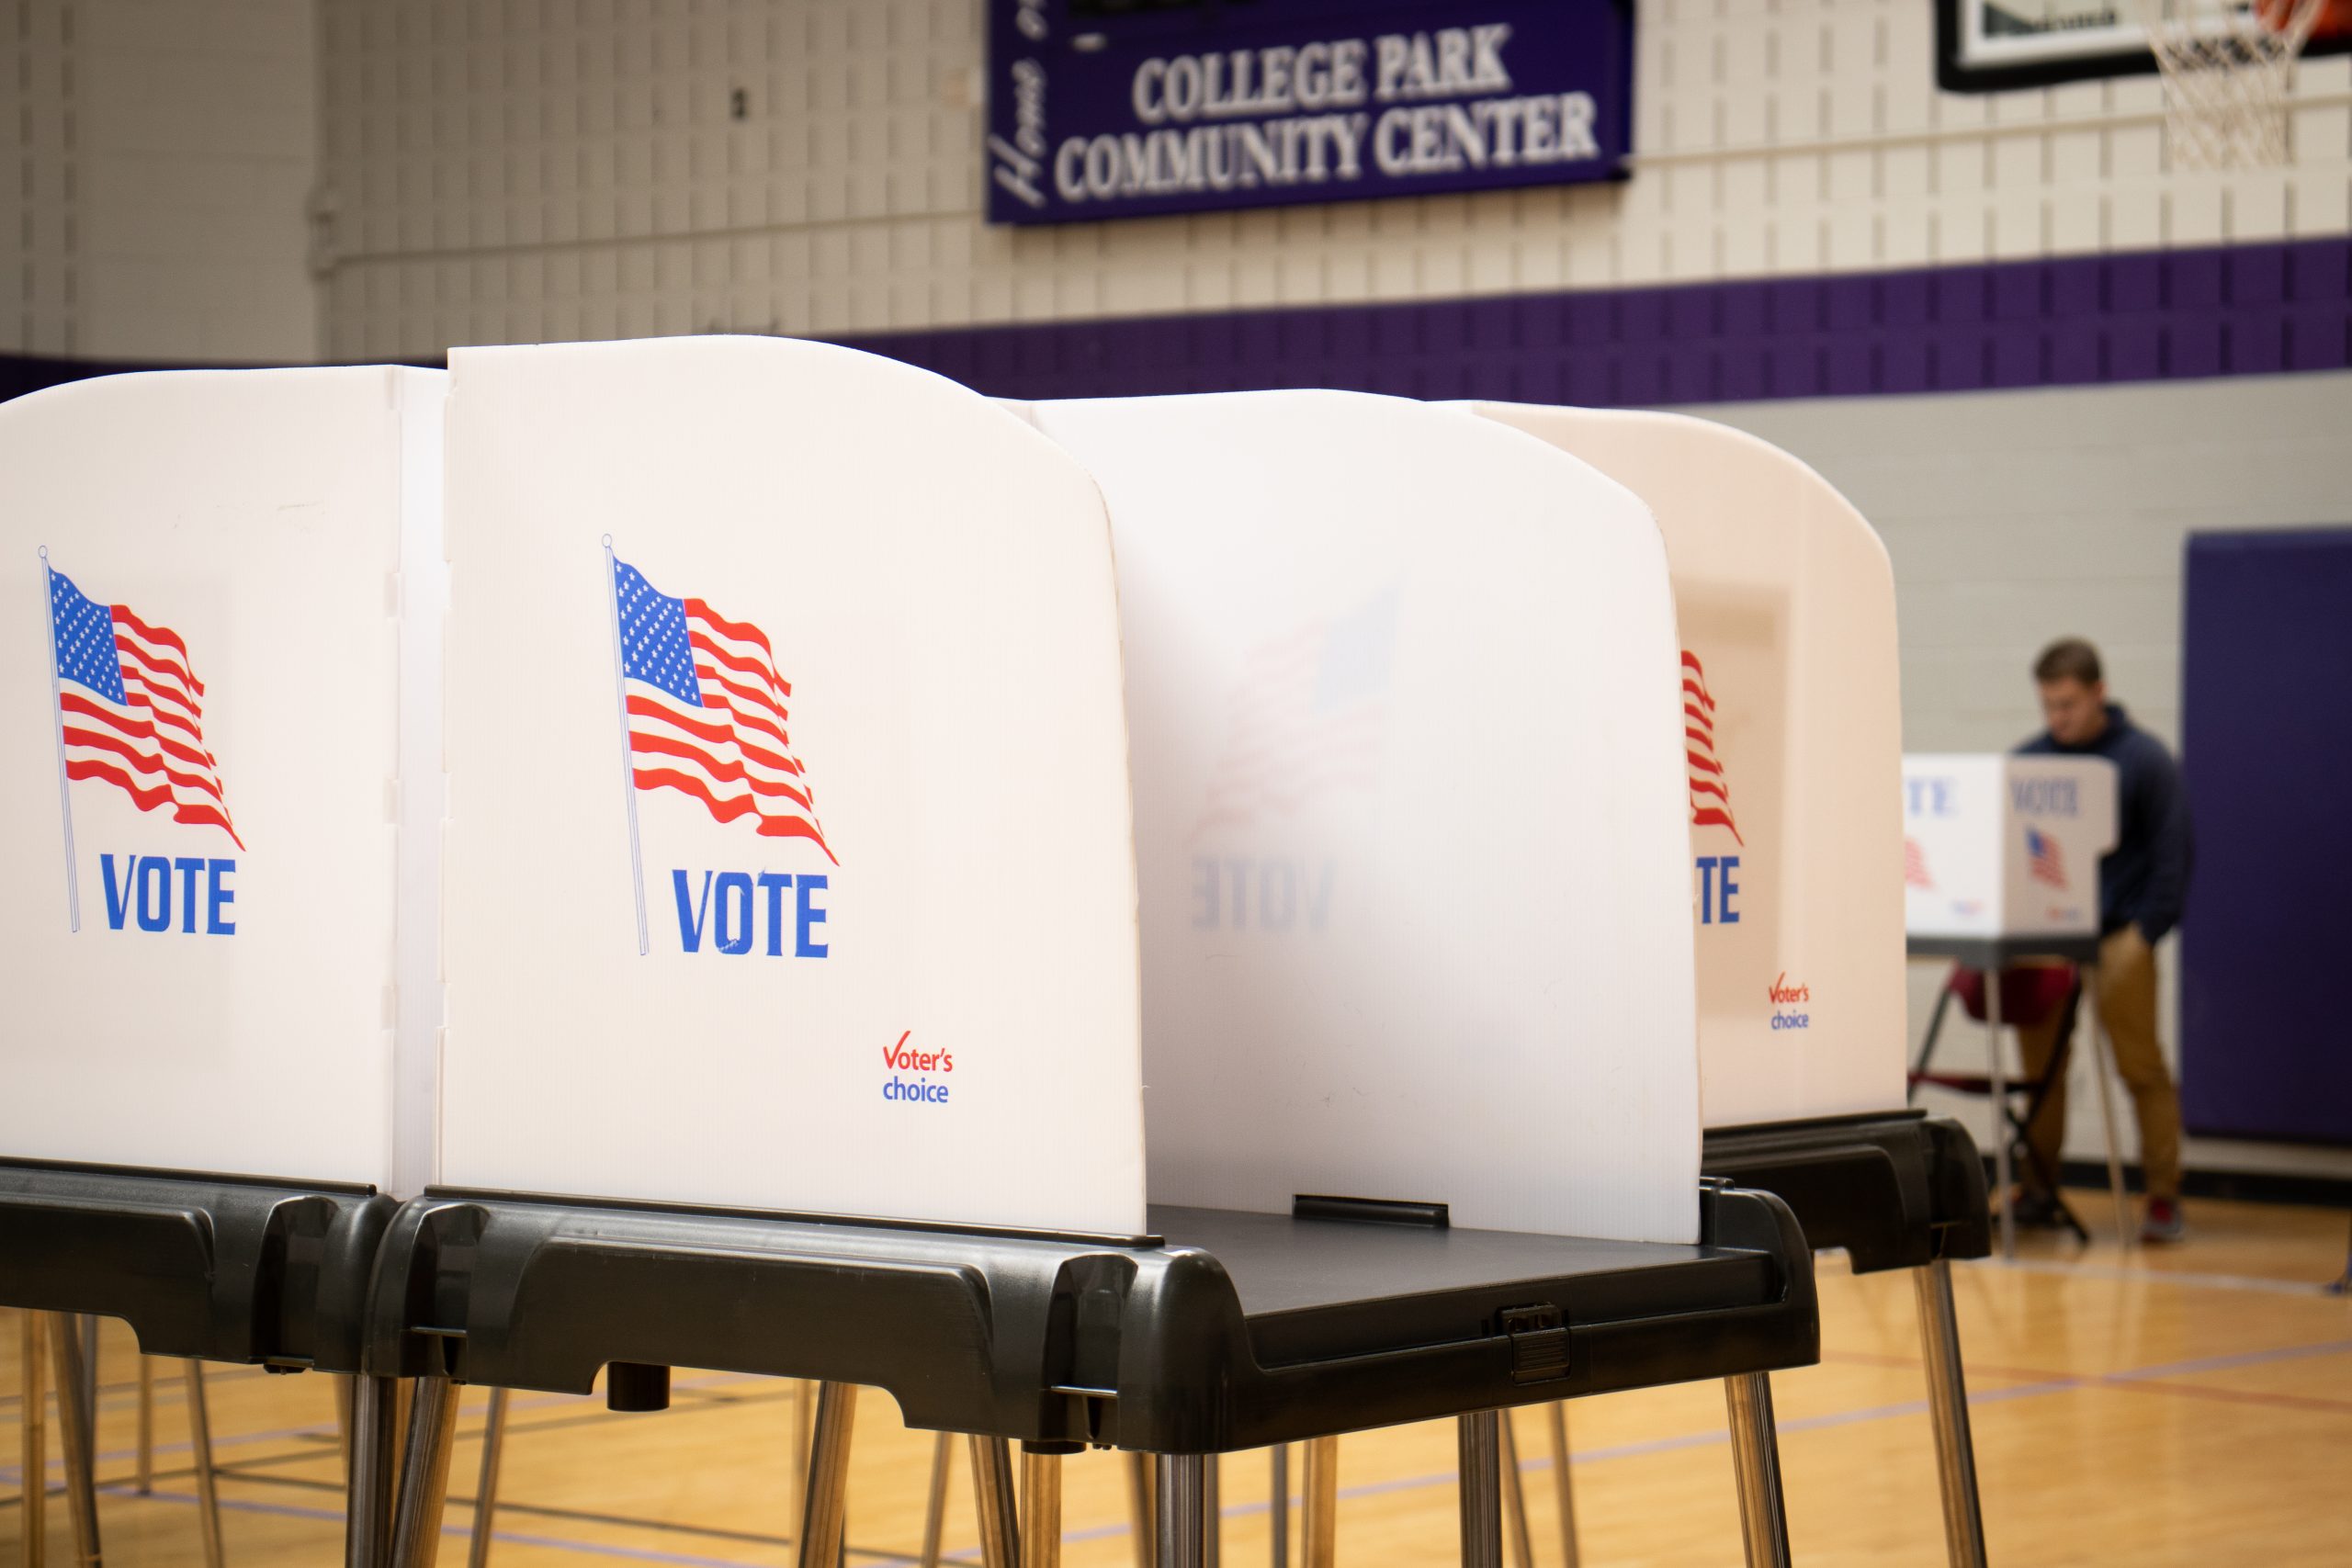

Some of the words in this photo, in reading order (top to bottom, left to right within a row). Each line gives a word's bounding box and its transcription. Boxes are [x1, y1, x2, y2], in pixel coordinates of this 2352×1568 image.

[1131, 39, 1367, 123] COLLEGE
[1372, 23, 1513, 96] PARK
[1055, 111, 1369, 201] COMMUNITY
[1374, 91, 1600, 176] CENTER
[1904, 777, 1958, 817] TE
[100, 853, 236, 936] VOTE
[672, 868, 829, 958] VOTE
[1695, 856, 1740, 924] TE
[1769, 972, 1809, 1004] Voter's
[1771, 1010, 1809, 1030] choice
[883, 1030, 953, 1072] Voter's
[883, 1076, 949, 1103] choice
